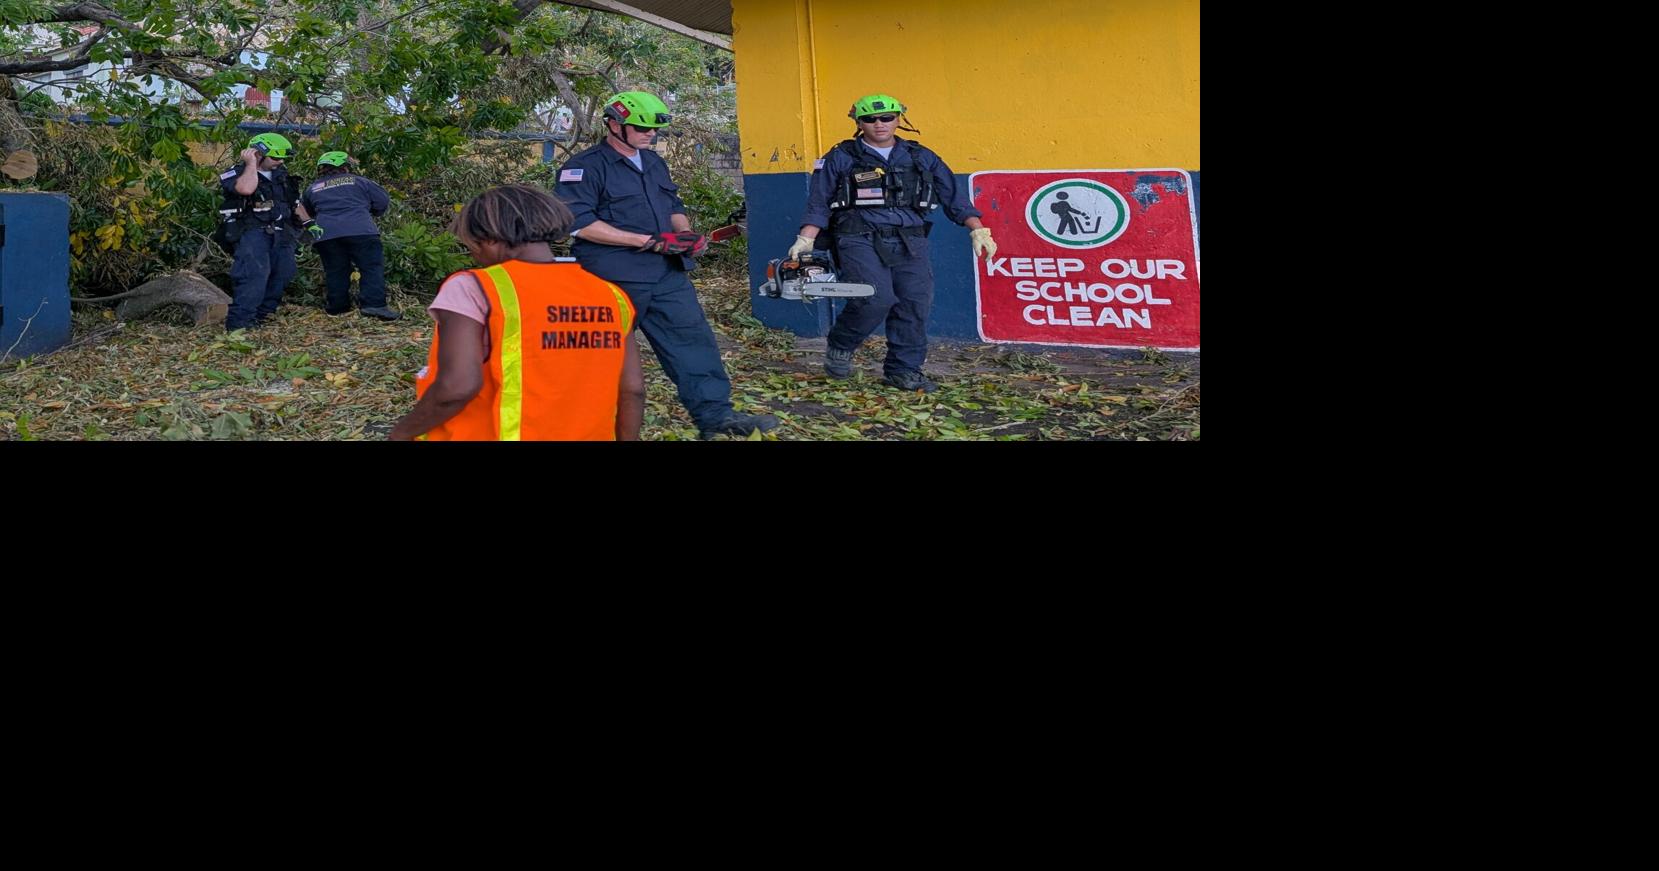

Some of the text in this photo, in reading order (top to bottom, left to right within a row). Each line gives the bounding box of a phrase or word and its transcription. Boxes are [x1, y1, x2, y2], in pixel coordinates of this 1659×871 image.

[986, 257, 1187, 280] KEEP OUR
[1015, 280, 1171, 305] SCHOOL
[546, 305, 614, 323] SHELTER
[1022, 304, 1151, 329] CLEAN
[541, 330, 621, 350] MANAGER
